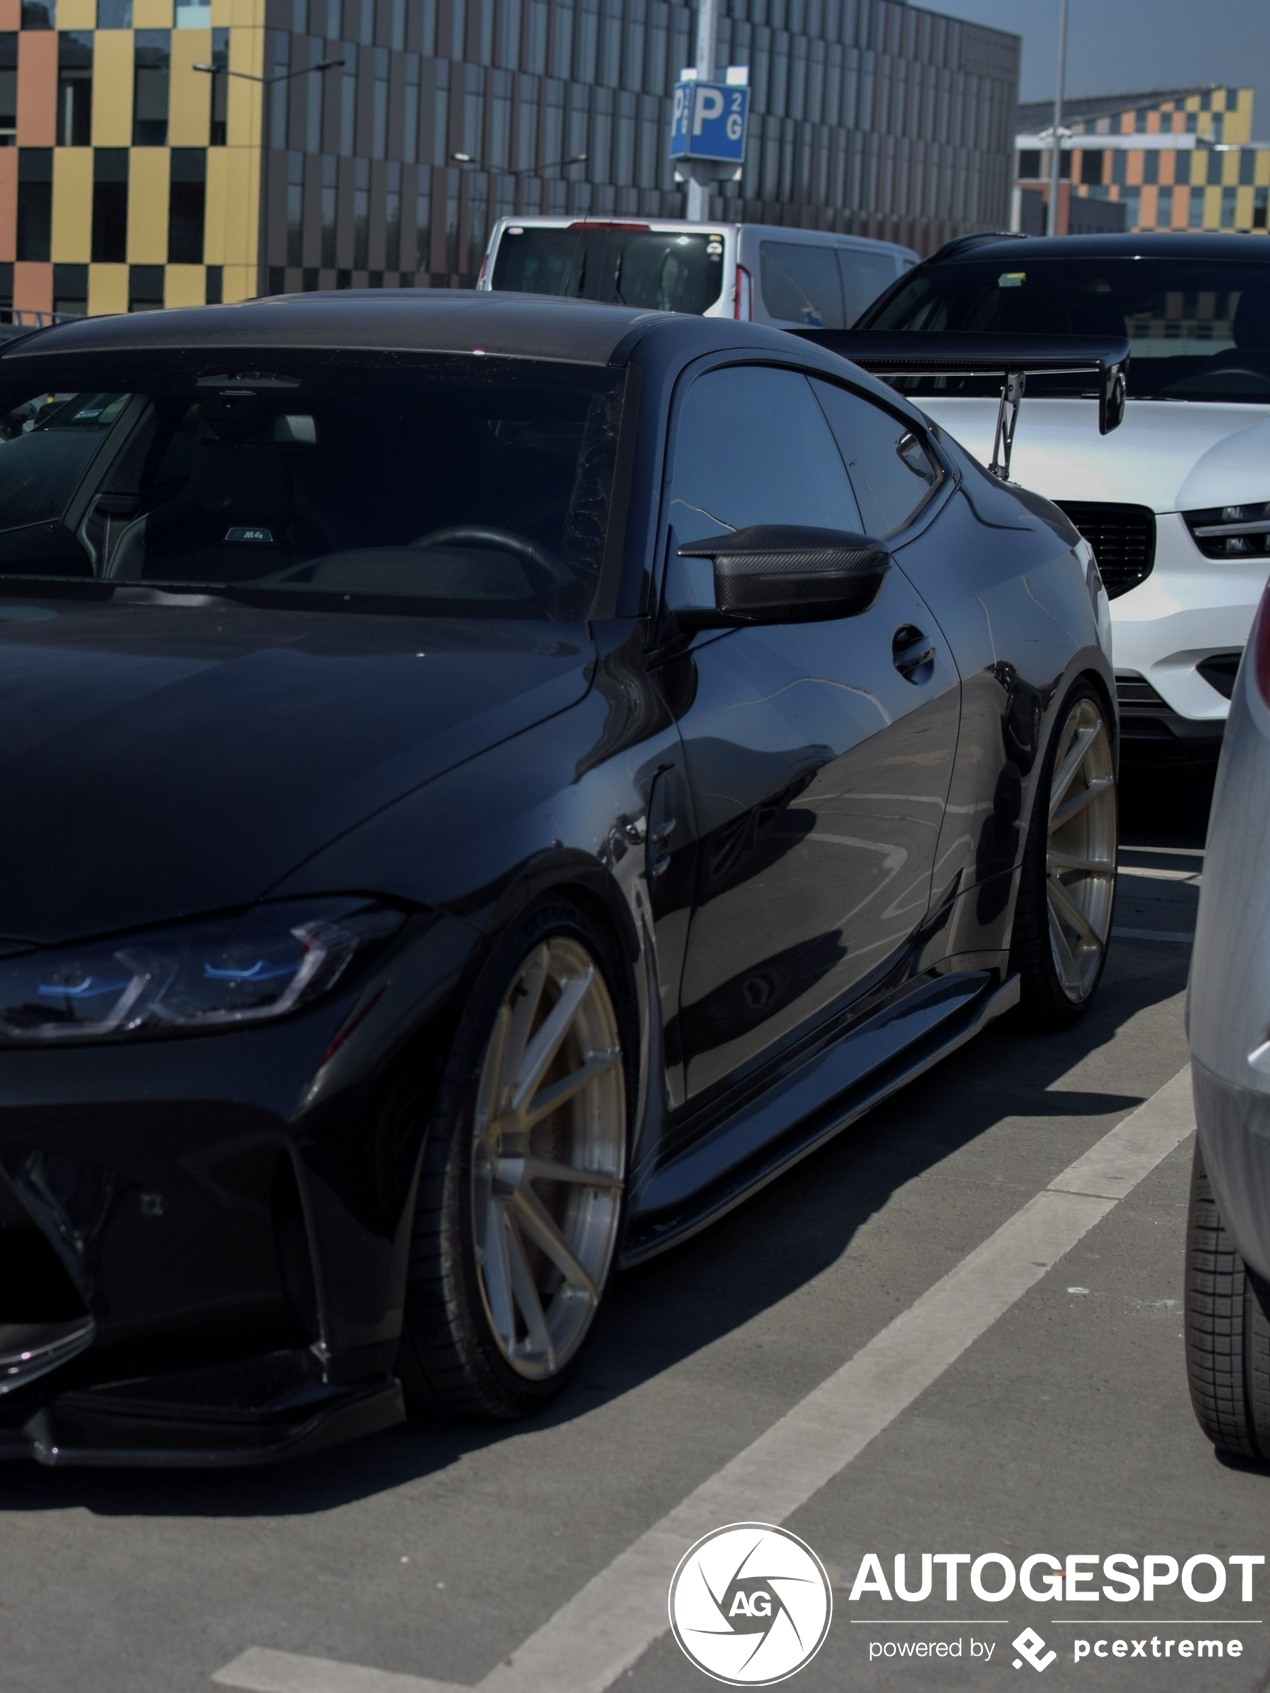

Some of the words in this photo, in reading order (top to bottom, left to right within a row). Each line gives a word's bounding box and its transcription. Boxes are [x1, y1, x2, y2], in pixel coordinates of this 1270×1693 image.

[693, 87, 724, 136] P
[731, 92, 742, 111] 2
[726, 113, 742, 141] G
